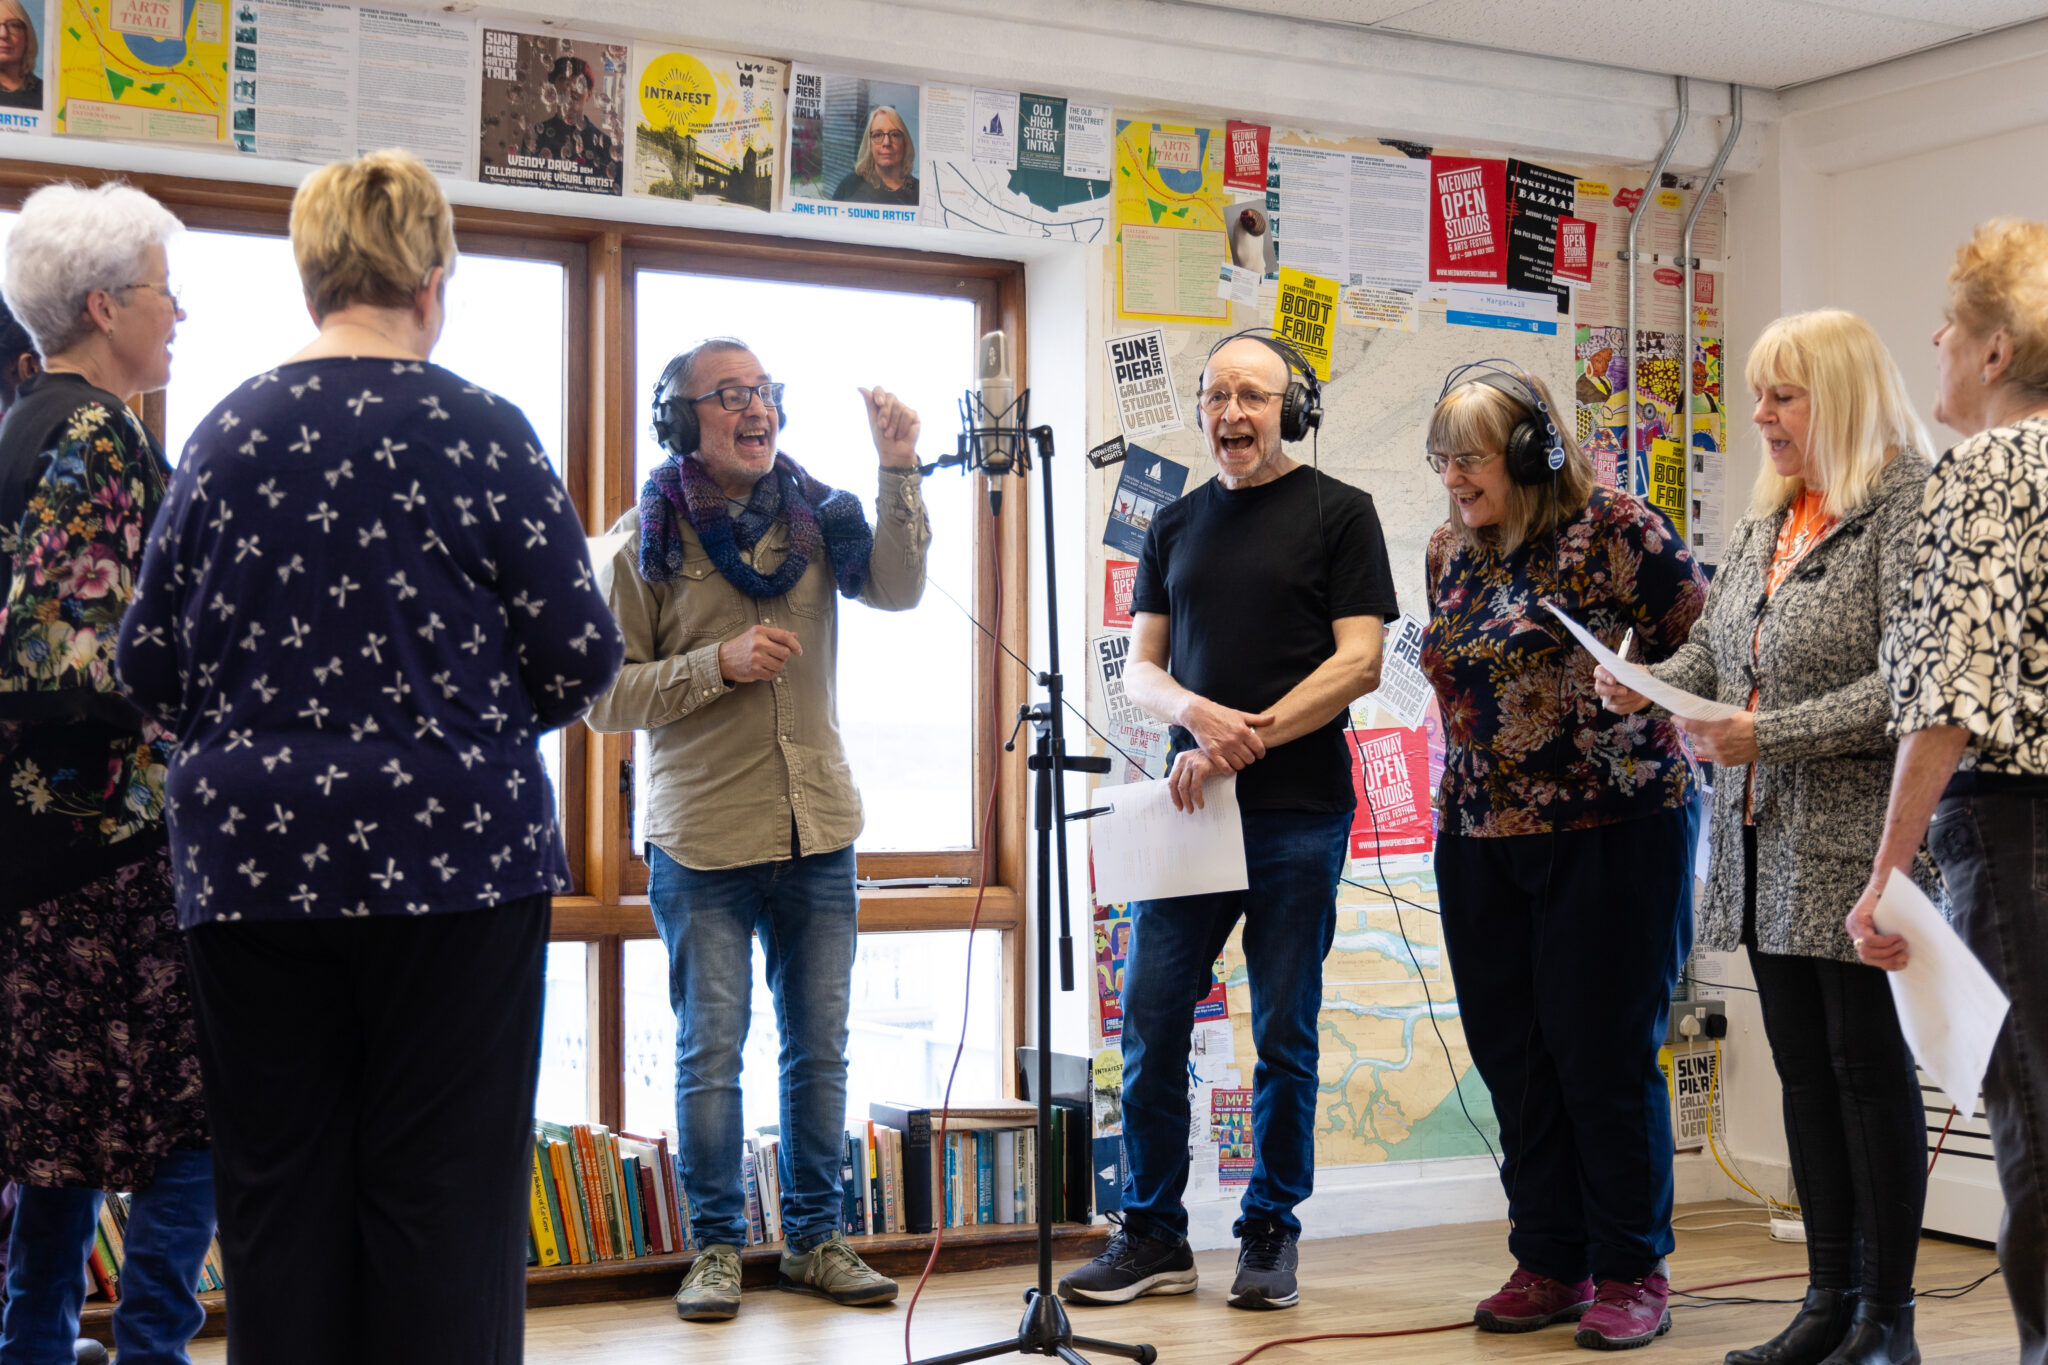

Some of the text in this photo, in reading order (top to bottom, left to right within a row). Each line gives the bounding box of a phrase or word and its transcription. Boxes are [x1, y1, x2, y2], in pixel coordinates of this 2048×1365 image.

[127, 0, 170, 15] ARTS
[120, 12, 171, 29] TRAIL
[486, 32, 511, 46] SUN
[486, 44, 512, 57] PIER
[486, 56, 516, 68] ARTIST
[486, 66, 517, 81] TALK
[796, 74, 814, 87] SUN
[644, 85, 712, 106] INTRAFEST
[796, 86, 814, 98] PIER
[796, 97, 820, 108] ARTIST
[1033, 104, 1052, 116] OLD
[795, 106, 820, 120] TALK
[1081, 108, 1092, 116] OLD
[1030, 117, 1054, 129] HIGH
[1069, 115, 1104, 126] HIGH STREET
[1069, 124, 1085, 132] INTRA
[1024, 127, 1059, 142] STREET
[1232, 131, 1257, 142] MEDWAY
[1027, 140, 1056, 153] INTRA
[1161, 140, 1190, 151] ARTS
[1232, 140, 1258, 154] OPEN
[508, 154, 546, 169] WENDY
[548, 159, 578, 172] DAWS
[1157, 150, 1192, 163] TRAIL
[1234, 154, 1260, 165] STUDIOS
[485, 165, 552, 181] COLLABORATIVE
[554, 173, 583, 184] VISUAL
[585, 176, 614, 188] ARTIST
[1438, 170, 1482, 194] MEDWAY
[1510, 175, 1546, 190] BROKEN
[1548, 184, 1574, 198] HEAR
[1441, 188, 1487, 220] OPEN
[792, 202, 815, 214] JANE
[818, 206, 838, 216] PITT
[848, 208, 880, 220] SOUND
[882, 210, 916, 222] ARTIST
[1445, 213, 1491, 239] STUDIOS
[1562, 225, 1585, 235] MEDWAY
[1454, 241, 1468, 251] ARTS
[1470, 236, 1494, 248] FESTIVAL
[1563, 234, 1586, 248] OPEN
[1564, 247, 1587, 257] STUDIOS
[1284, 284, 1332, 304] CHATHAM INTRA
[1281, 292, 1332, 324] BOOT
[1282, 315, 1325, 346] FAIR
[1112, 338, 1148, 364] SUN
[1148, 336, 1164, 376] HOUSE
[1115, 360, 1152, 384] PIER
[1119, 376, 1166, 398] GALLERY
[1122, 390, 1170, 412] STUDIOS
[1125, 405, 1174, 430] VENUE
[1091, 442, 1122, 459] NOWHERE
[1101, 450, 1122, 462] NIGHTS
[1598, 461, 1615, 473] OPEN
[1654, 462, 1685, 488] BOO
[1402, 621, 1423, 648] SU
[1388, 654, 1430, 690] GALLERY
[1383, 666, 1424, 704] STUDIOS
[1120, 726, 1160, 742] LITTLE PIECES
[1130, 737, 1148, 748] OF ME
[1358, 736, 1402, 764] MEDWAY
[1362, 752, 1408, 791] OPEN
[1368, 780, 1414, 810] STUDIOS
[1377, 804, 1416, 824] ARTS FESTIVAL
[1106, 1018, 1118, 1026] FREE
[1095, 1064, 1124, 1076] INTRAFEST
[1678, 1055, 1708, 1078] SUN
[1679, 1078, 1710, 1096] PIER
[1225, 1094, 1243, 1106] MY
[542, 1216, 550, 1233] Gene
